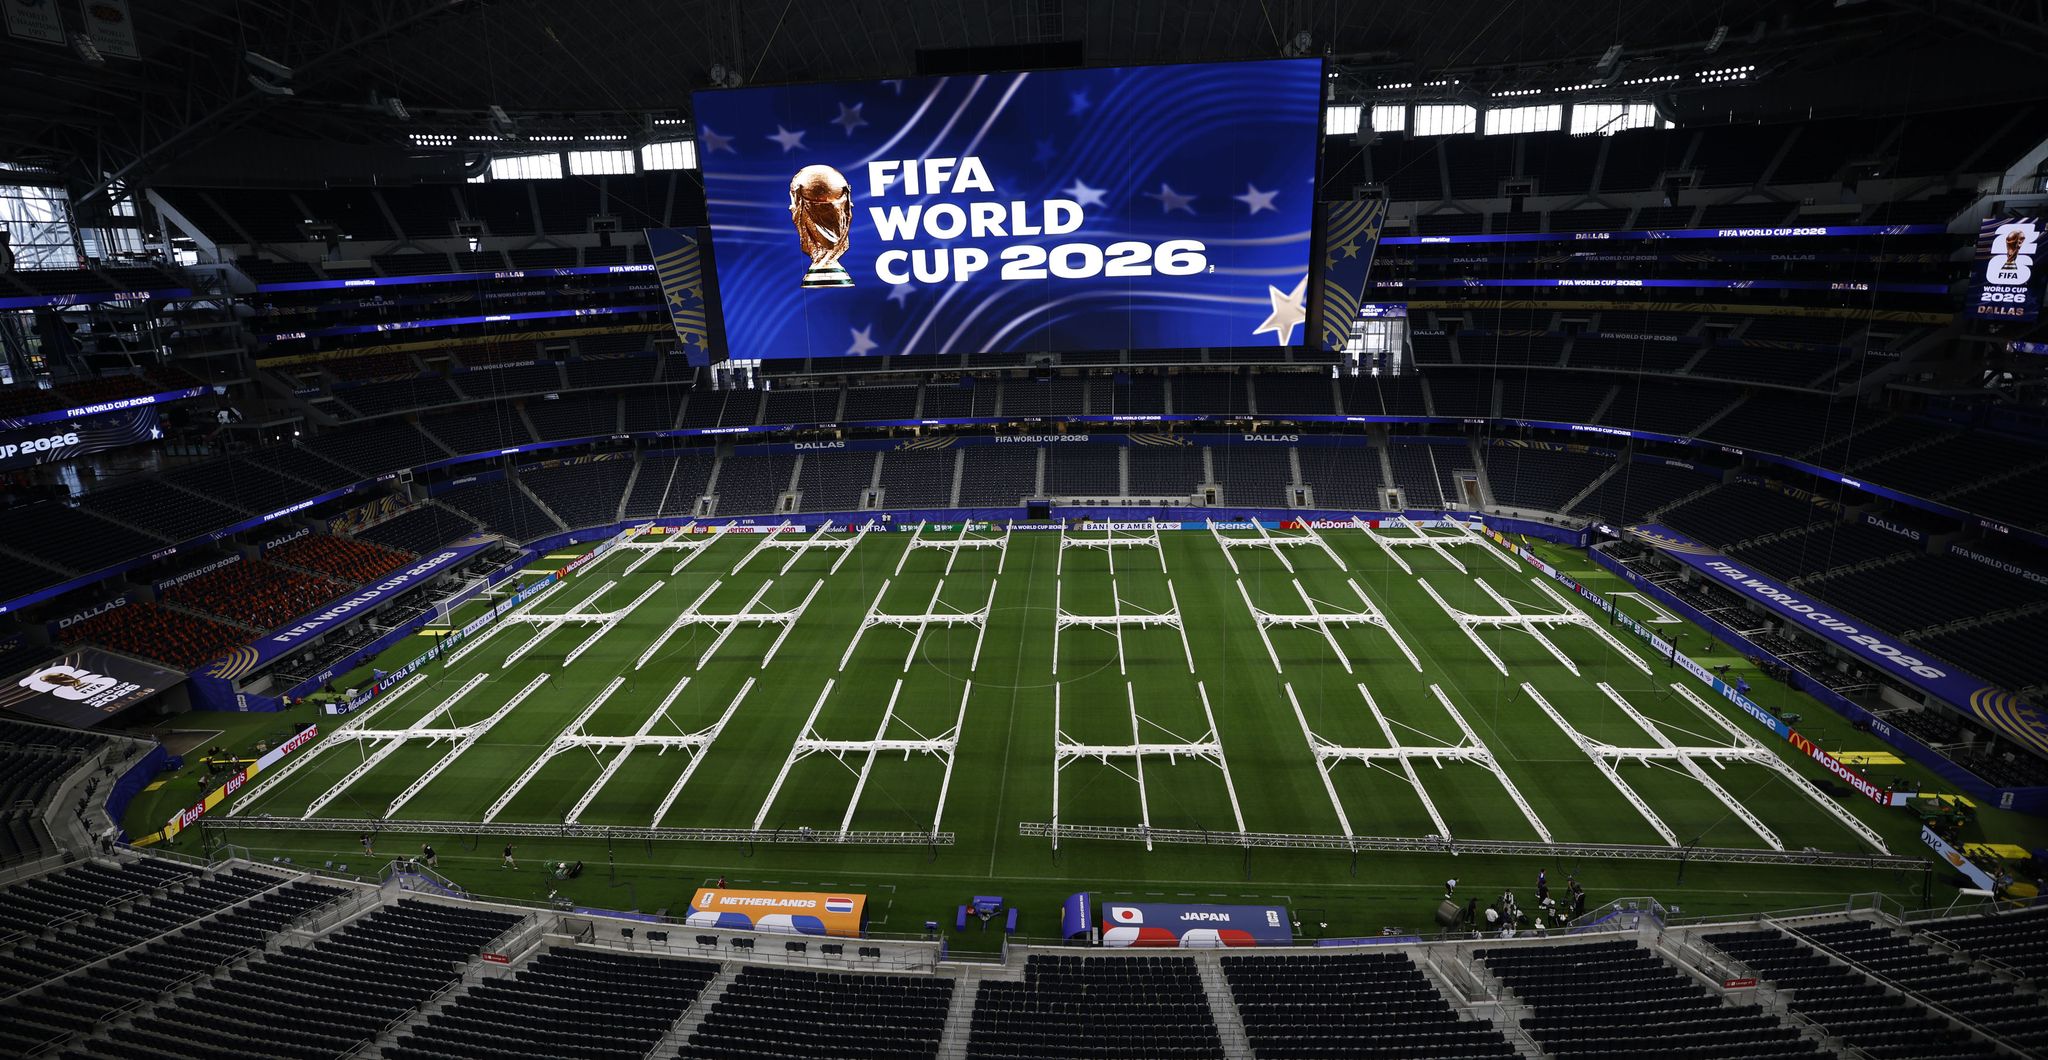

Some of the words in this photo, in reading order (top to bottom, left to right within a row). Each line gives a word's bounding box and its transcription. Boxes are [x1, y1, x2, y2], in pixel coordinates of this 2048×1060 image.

[869, 156, 995, 198] FIFA
[869, 199, 1084, 242] WORLD
[1792, 227, 1827, 235] 2026
[875, 248, 989, 286] CUP
[1000, 240, 1207, 281] 2026
[495, 271, 525, 279] DALLAS
[115, 291, 150, 301] DALLAS
[1980, 293, 2026, 303] 2026
[1977, 306, 2024, 316] DALLAS
[276, 332, 306, 341] DALLAS
[67, 408, 85, 417] FIFA
[86, 402, 113, 413] WORLD
[114, 399, 129, 409] CUP
[129, 396, 156, 406] 2026
[0, 444, 18, 460] UP
[20, 432, 79, 455] 2026
[795, 441, 845, 450] DALLAS
[1060, 434, 1089, 442] 2026
[1244, 434, 1299, 442] DALLAS
[264, 513, 275, 521] FIFA
[274, 508, 290, 517] WORLD
[299, 500, 314, 510] 2026
[1867, 516, 1920, 540] DALLAS
[266, 528, 310, 550] DALLAS
[159, 579, 176, 590] FIFA
[175, 569, 202, 584] WORLD
[203, 563, 217, 574] CUP
[217, 554, 241, 568] 2026
[566, 552, 594, 573] McDonald's
[1952, 545, 1969, 558] FIFA
[1970, 552, 2002, 569] WORLD
[2003, 563, 2022, 575] CUP
[2022, 570, 2048, 586] 202
[272, 616, 324, 643] FIFA
[315, 590, 382, 621] WORLD
[376, 573, 409, 592] CUP
[406, 551, 459, 577] 2026
[518, 578, 550, 602] Hisense
[1581, 587, 1602, 607] ULTRA
[59, 597, 126, 629] DALLAS
[1705, 561, 1749, 580] FIFA
[1742, 579, 1815, 615] WORLD
[1806, 612, 1859, 635] CUP
[1847, 633, 1947, 679] 2026
[318, 669, 333, 683] FIFA
[1676, 655, 1706, 680] AMERICA
[80, 683, 106, 695] FIFA
[380, 668, 408, 691] ULTRA
[103, 688, 156, 712] DALLAS
[1722, 684, 1777, 731] Hisense
[1871, 719, 1891, 736] FIFA
[226, 770, 247, 795] Lay's
[1812, 748, 1883, 806] McDonald's
[183, 803, 204, 828] Lay's
[1921, 829, 1943, 849] ove
[720, 896, 817, 909] NETHERLANDS
[1180, 911, 1231, 924] JAPAN
